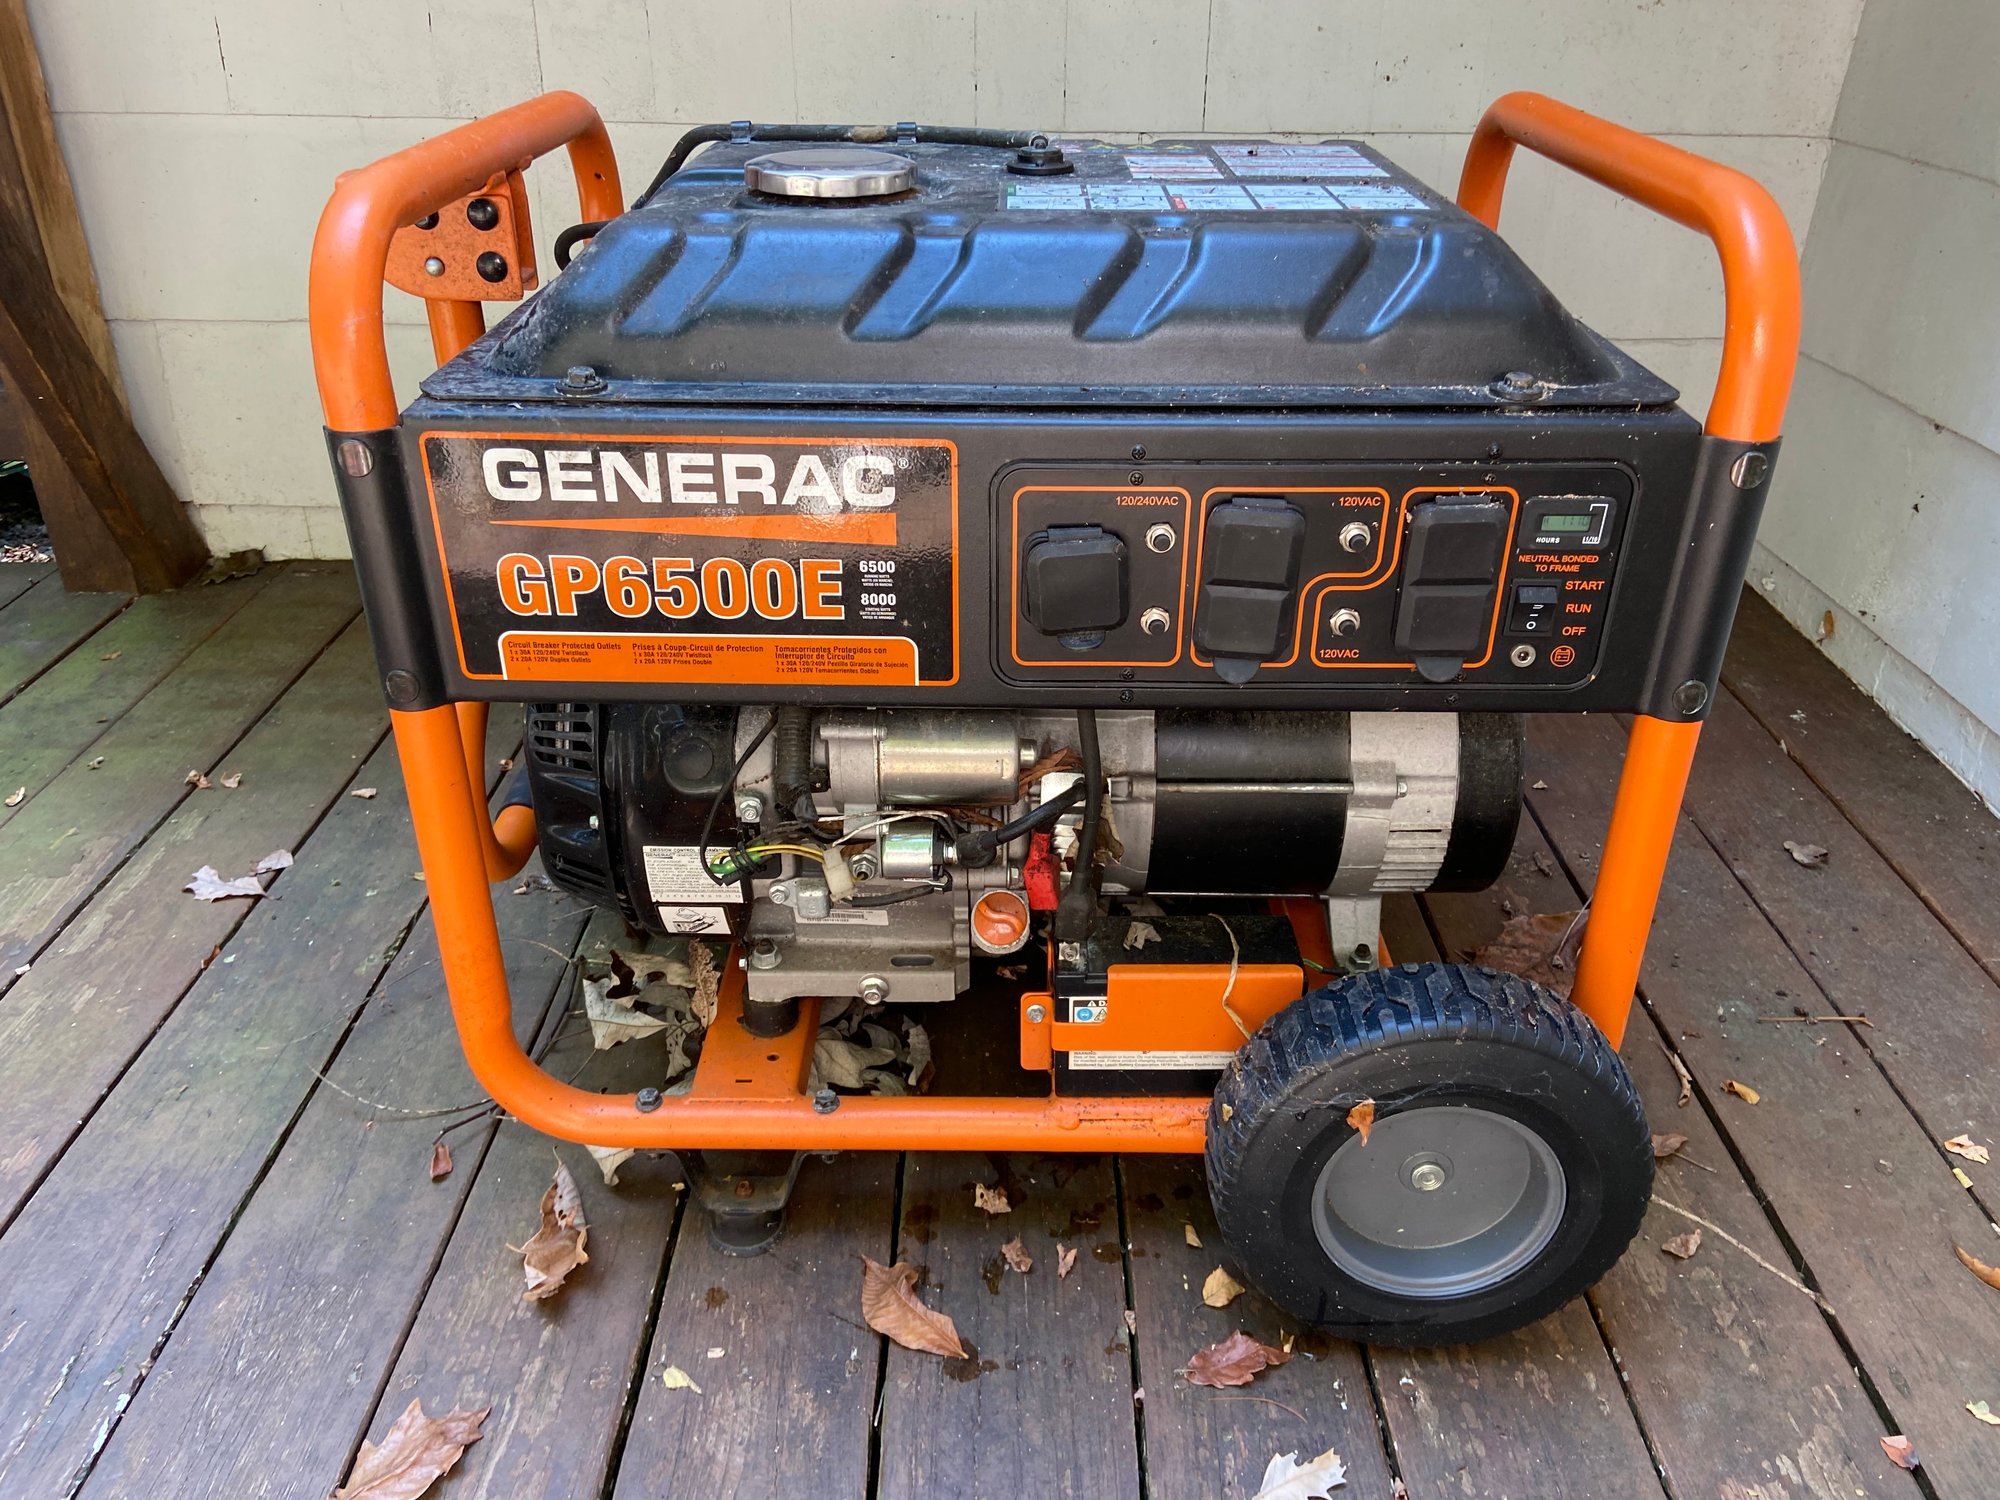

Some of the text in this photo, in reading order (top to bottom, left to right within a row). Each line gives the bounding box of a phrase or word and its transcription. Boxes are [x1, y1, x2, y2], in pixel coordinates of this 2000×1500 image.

[1115, 496, 1179, 506] 120/240VAC
[1338, 496, 1381, 507] 120VAC
[1518, 554, 1600, 563] NEUTRAL BONDED
[859, 561, 896, 573] 6500
[1535, 564, 1581, 572] TO FRAME
[496, 552, 845, 621] GP6500E
[1564, 581, 1605, 591] START
[861, 593, 896, 606] 8000
[1565, 603, 1592, 613] RUN
[1562, 626, 1586, 636] OFF
[533, 641, 559, 649] Breaker
[562, 642, 595, 650] Protected
[597, 642, 622, 650] Outlets
[664, 643, 713, 652] Coupe-Circuit
[715, 644, 724, 652] de
[726, 644, 764, 652] Protection
[775, 645, 831, 653] Tomacorrientes
[833, 646, 872, 655] Protegidos
[775, 653, 814, 661] Interruptor
[827, 653, 855, 661] Circuito
[1319, 649, 1360, 658] 120VAC
